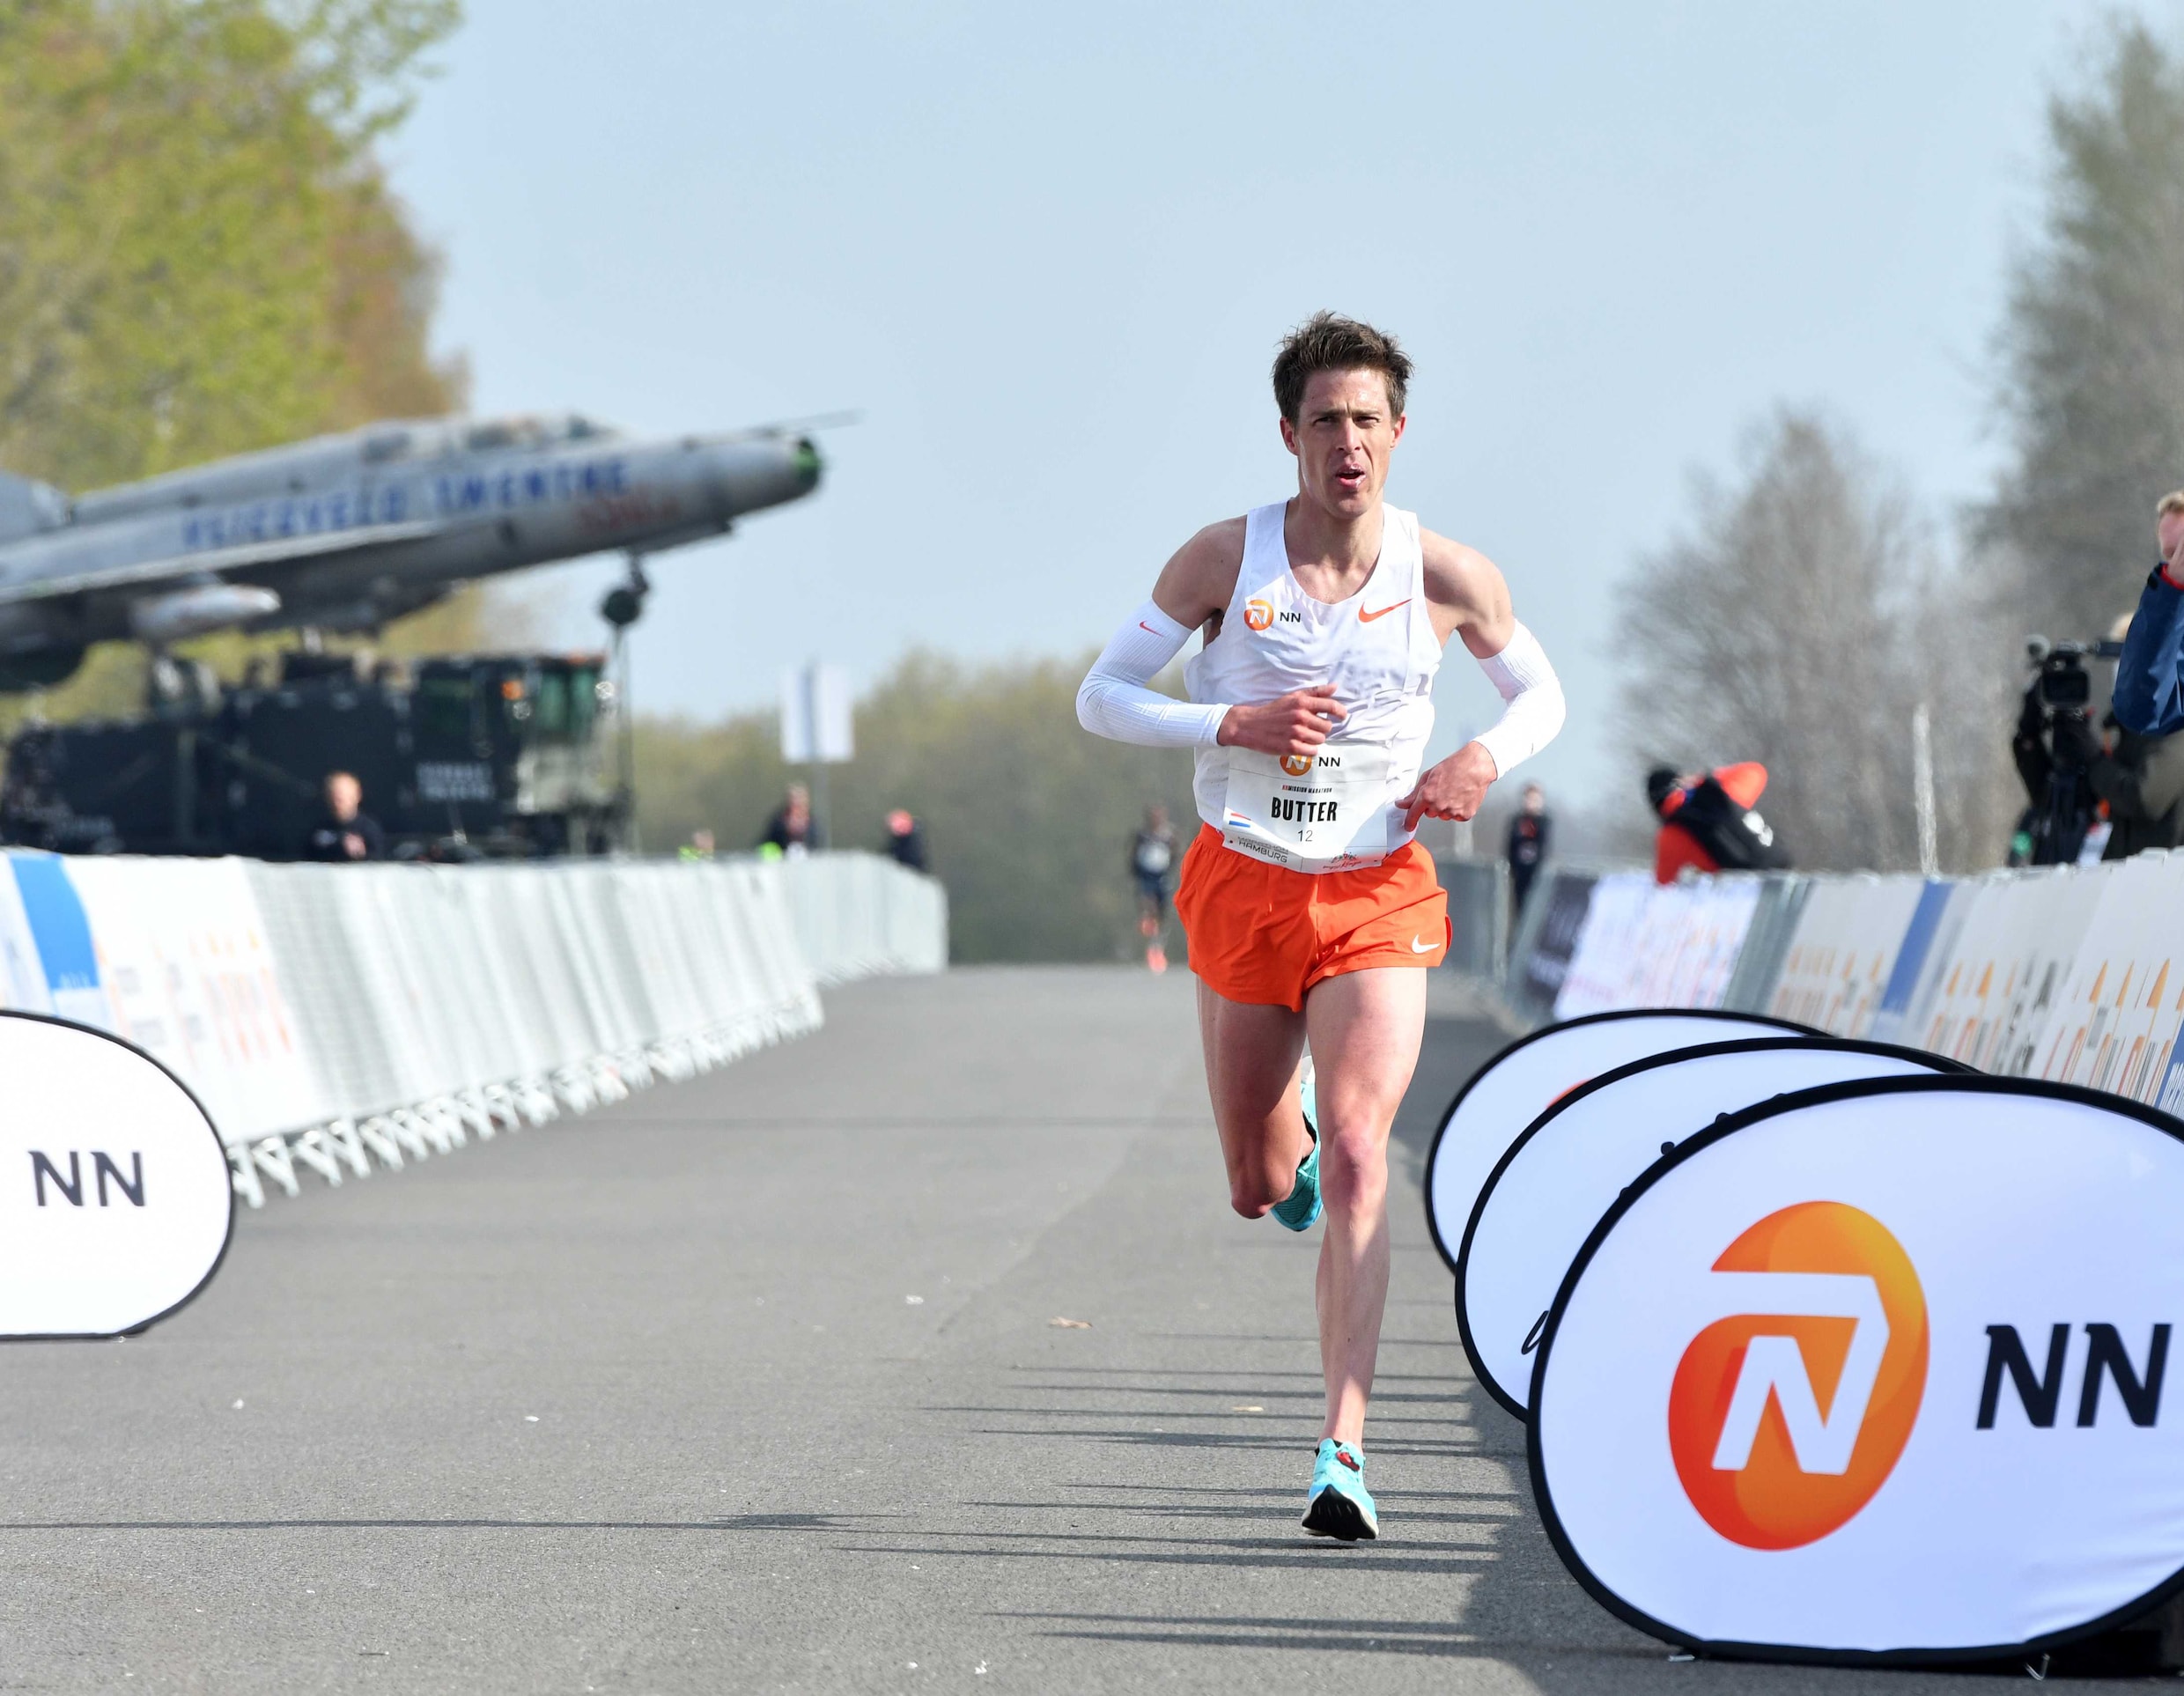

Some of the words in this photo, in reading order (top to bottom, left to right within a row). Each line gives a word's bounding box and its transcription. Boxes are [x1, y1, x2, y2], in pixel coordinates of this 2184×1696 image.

[1280, 611, 1301, 623] NN
[1318, 756, 1340, 767] NN
[1271, 796, 1338, 822] BUTTER
[1298, 830, 1313, 842] 12
[1238, 840, 1288, 863] HAMBURG
[27, 1151, 146, 1206] NN
[1974, 1323, 2173, 1431] NN
